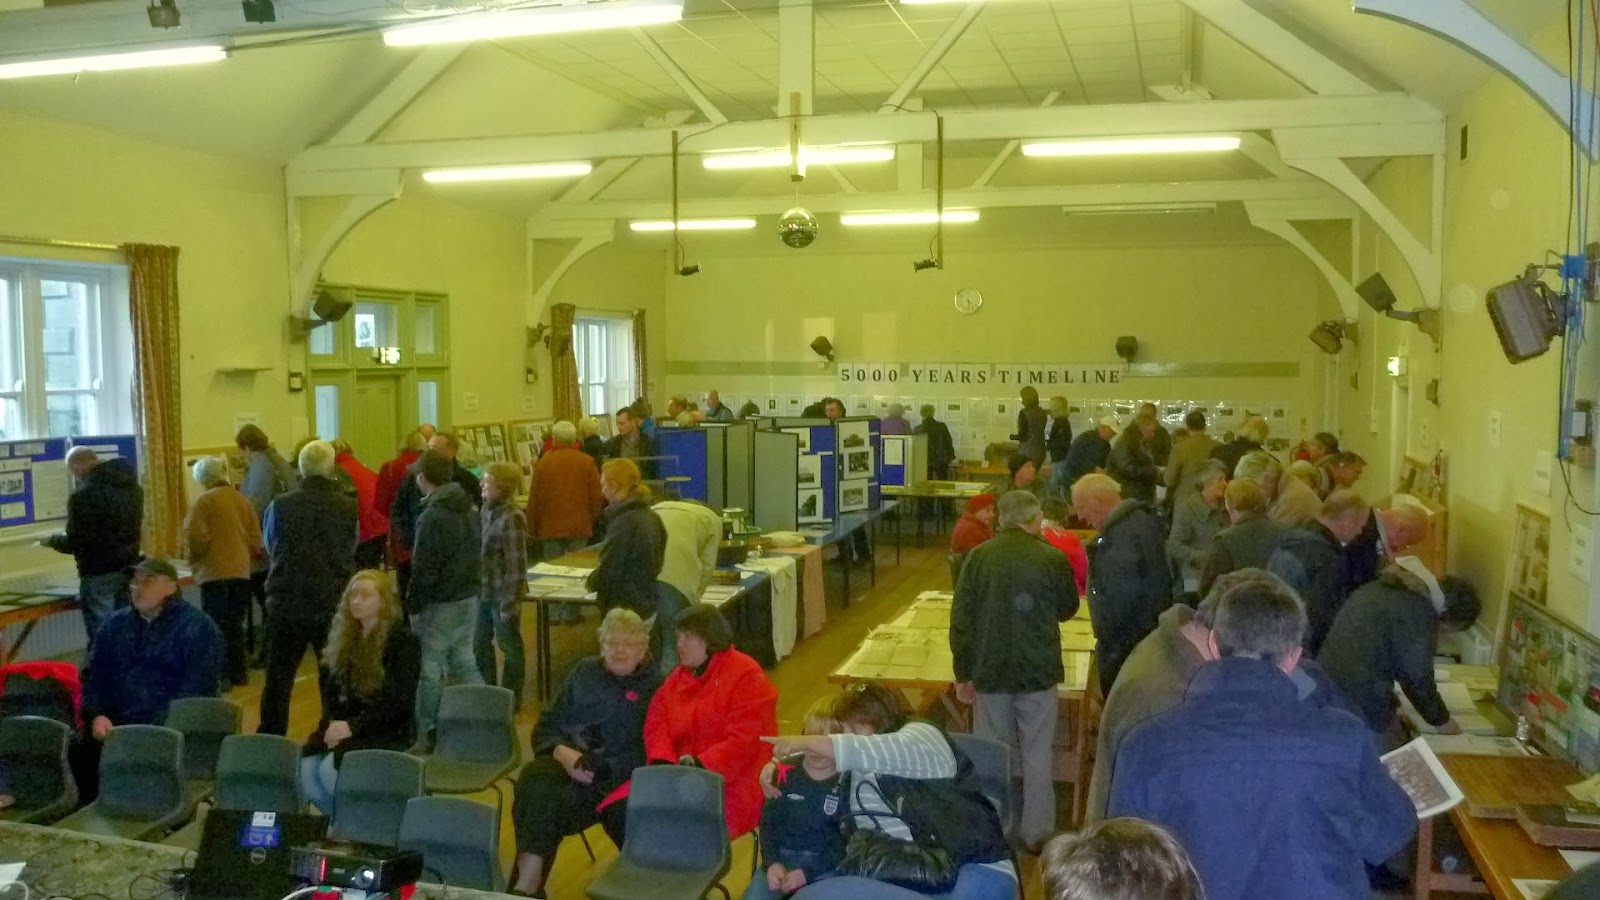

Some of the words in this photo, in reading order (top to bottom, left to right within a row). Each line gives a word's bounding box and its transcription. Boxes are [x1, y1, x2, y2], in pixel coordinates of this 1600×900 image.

[841, 368, 898, 382] 5000
[912, 369, 987, 384] YEARS
[998, 369, 1120, 384] TIMELINE
